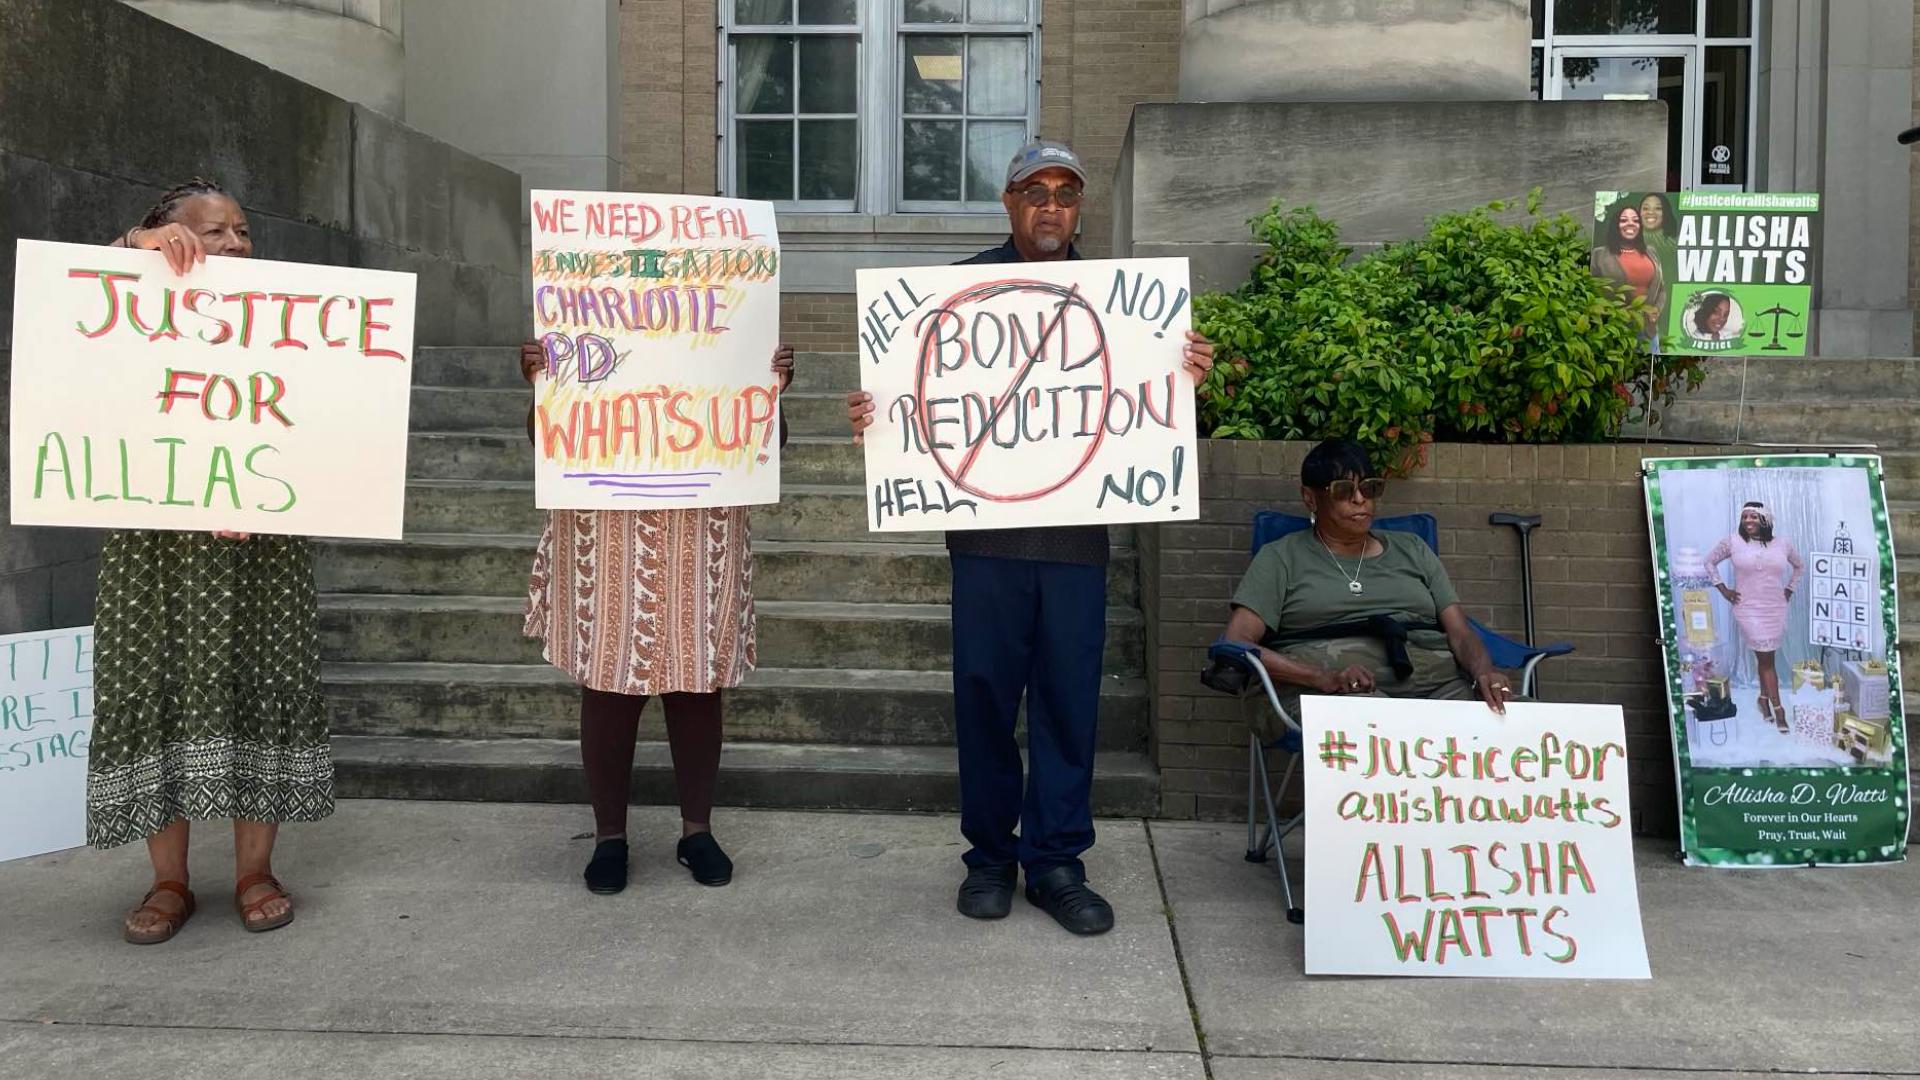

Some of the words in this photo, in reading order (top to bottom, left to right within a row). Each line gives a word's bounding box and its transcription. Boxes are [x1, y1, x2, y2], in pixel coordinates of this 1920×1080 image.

[532, 198, 579, 236] WE
[585, 202, 664, 244] NEED
[670, 204, 766, 241] REAL
[1682, 194, 1817, 208] #justiceforallishawatts
[1677, 214, 1810, 248] ALLISHA
[539, 248, 778, 279] INVESTIGATION
[1677, 249, 1806, 284] WATTS
[68, 268, 407, 362] JUSTICE
[536, 285, 730, 334] CHARLOTTE
[861, 277, 936, 365] HELL
[1105, 268, 1189, 339] NO!
[543, 331, 618, 383] PD
[914, 299, 1105, 378] BOND
[1692, 340, 1731, 350] JUSTICE
[155, 367, 296, 427] FOR
[889, 371, 1178, 455] REDUCTION
[536, 384, 705, 460] WHAT'S
[708, 384, 779, 466] UP!
[33, 431, 297, 513] ALLIAS
[1096, 445, 1185, 513] NO!
[874, 476, 978, 529] HELL
[1318, 723, 1626, 783] #justicefor
[1337, 786, 1622, 829] allishawatts
[1704, 782, 1787, 806] Allisha
[1790, 783, 1821, 805] D.
[1826, 783, 1888, 806] Watts
[1743, 812, 1785, 823] Forever
[1788, 812, 1799, 823] in
[1801, 812, 1821, 823] Our
[1824, 812, 1858, 823] Hearts
[1758, 830, 1786, 842] Pray,
[1787, 830, 1820, 841] Trust,
[1822, 830, 1846, 840] Wait
[1354, 841, 1596, 903] ALLISHA
[1380, 905, 1578, 965] WATTS
